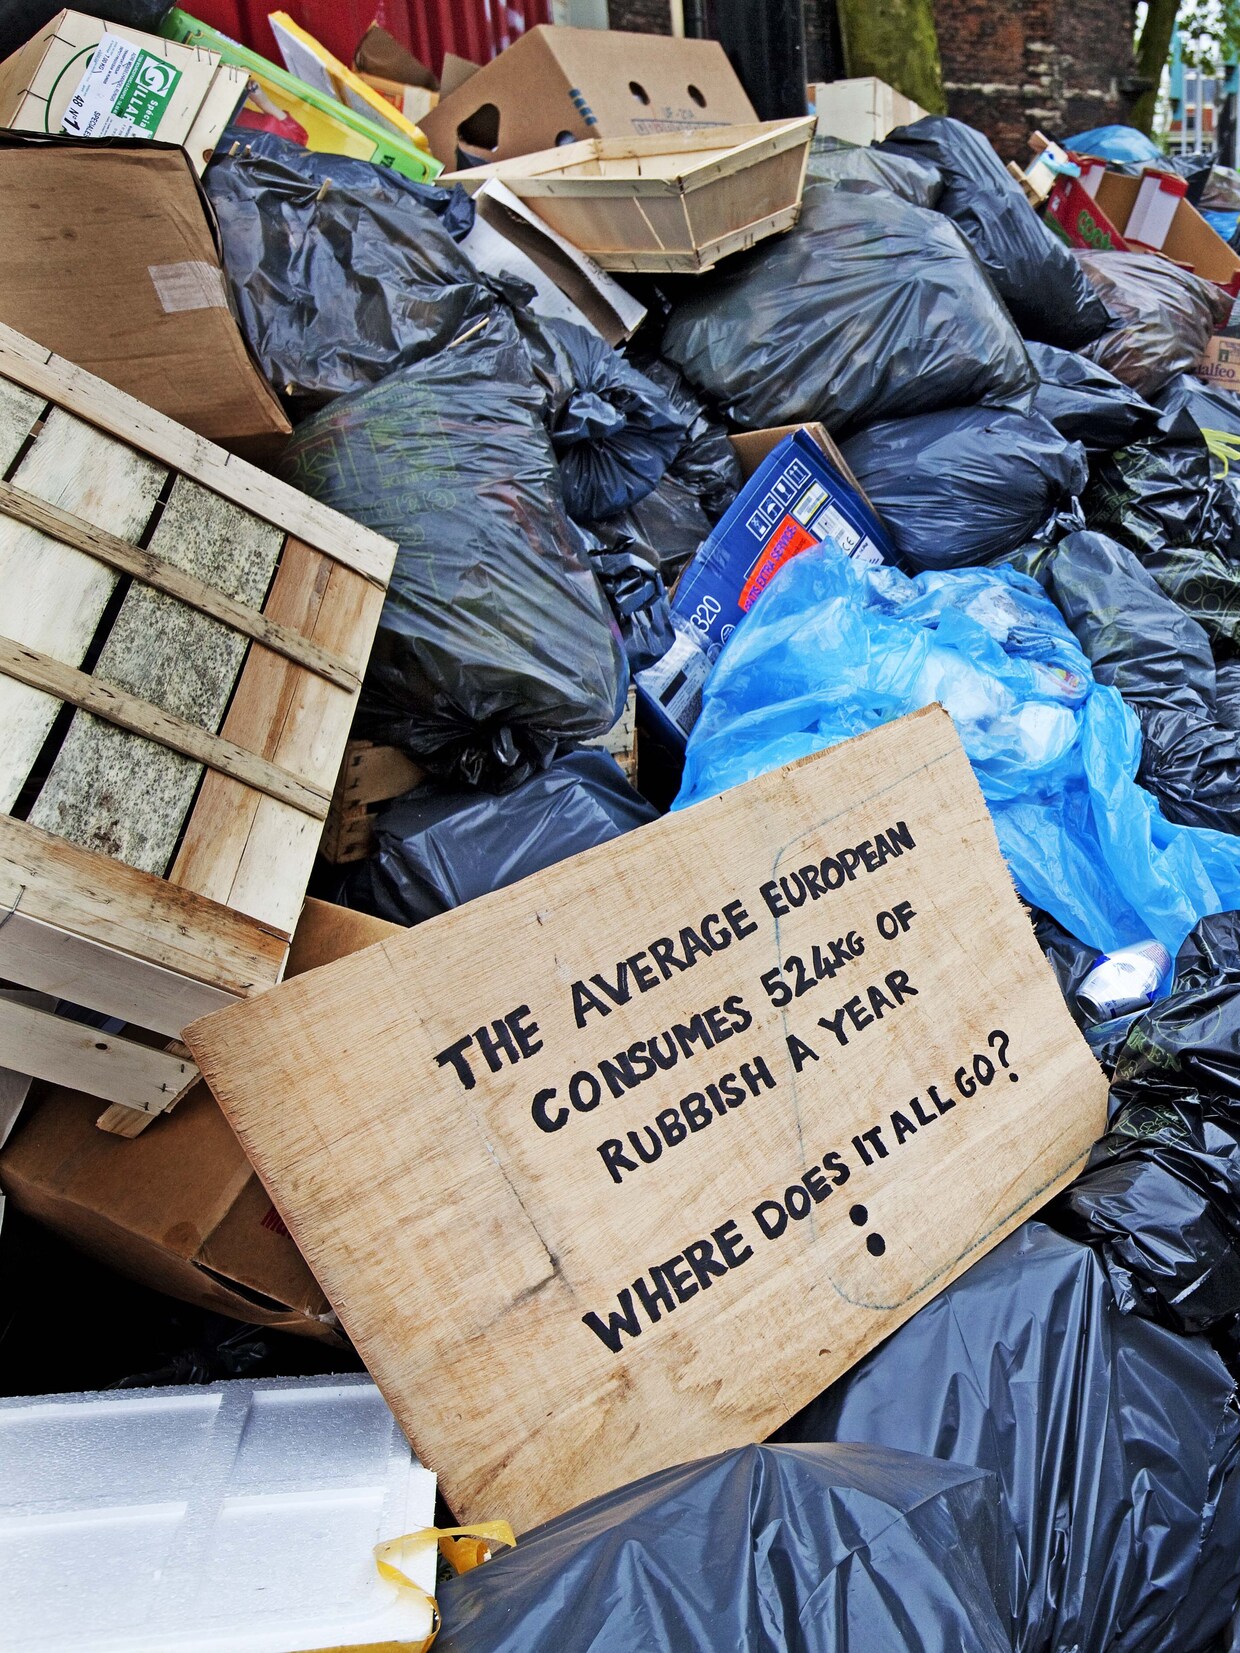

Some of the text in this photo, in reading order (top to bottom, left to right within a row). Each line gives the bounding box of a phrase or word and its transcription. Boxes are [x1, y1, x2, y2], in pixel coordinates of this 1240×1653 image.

[72, 95, 84, 107] 48
[755, 561, 776, 585] EXTRA
[433, 822, 916, 1089] THE AVERAGE EUROPEAN
[532, 996, 752, 1132] CONSUMES
[877, 901, 917, 940] OF
[597, 970, 918, 1183] RUBBISH A YEAR
[582, 1220, 754, 1353] WHERE
[752, 1152, 850, 1240] DOES
[851, 1126, 889, 1166] IT
[890, 1086, 956, 1144] ALL
